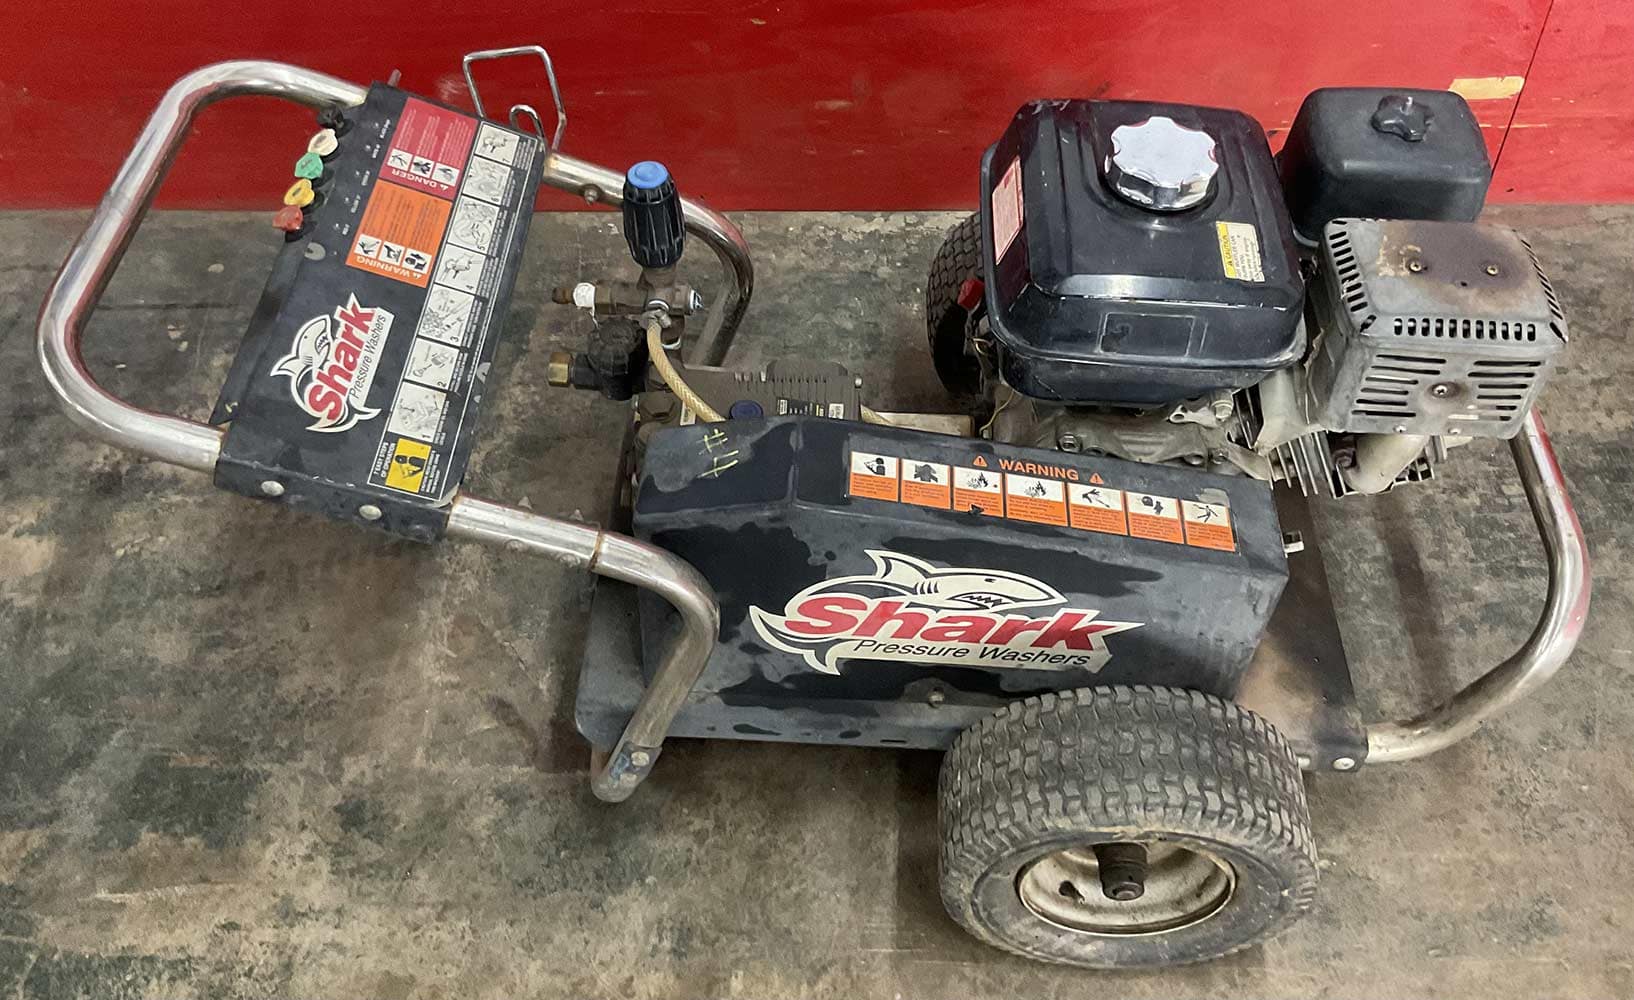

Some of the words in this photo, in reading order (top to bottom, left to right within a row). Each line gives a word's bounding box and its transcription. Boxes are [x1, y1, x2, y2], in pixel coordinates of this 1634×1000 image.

[391, 168, 437, 188] DANGER
[356, 256, 411, 278] WARNING
[308, 303, 376, 421] Shark
[349, 356, 373, 399] Pressure
[364, 314, 386, 355] Washers
[383, 443, 396, 470] OPERATION
[999, 458, 1079, 480] WARNING
[784, 596, 1119, 651] Shark
[853, 639, 968, 658] Pressure
[979, 646, 1090, 666] Washers
